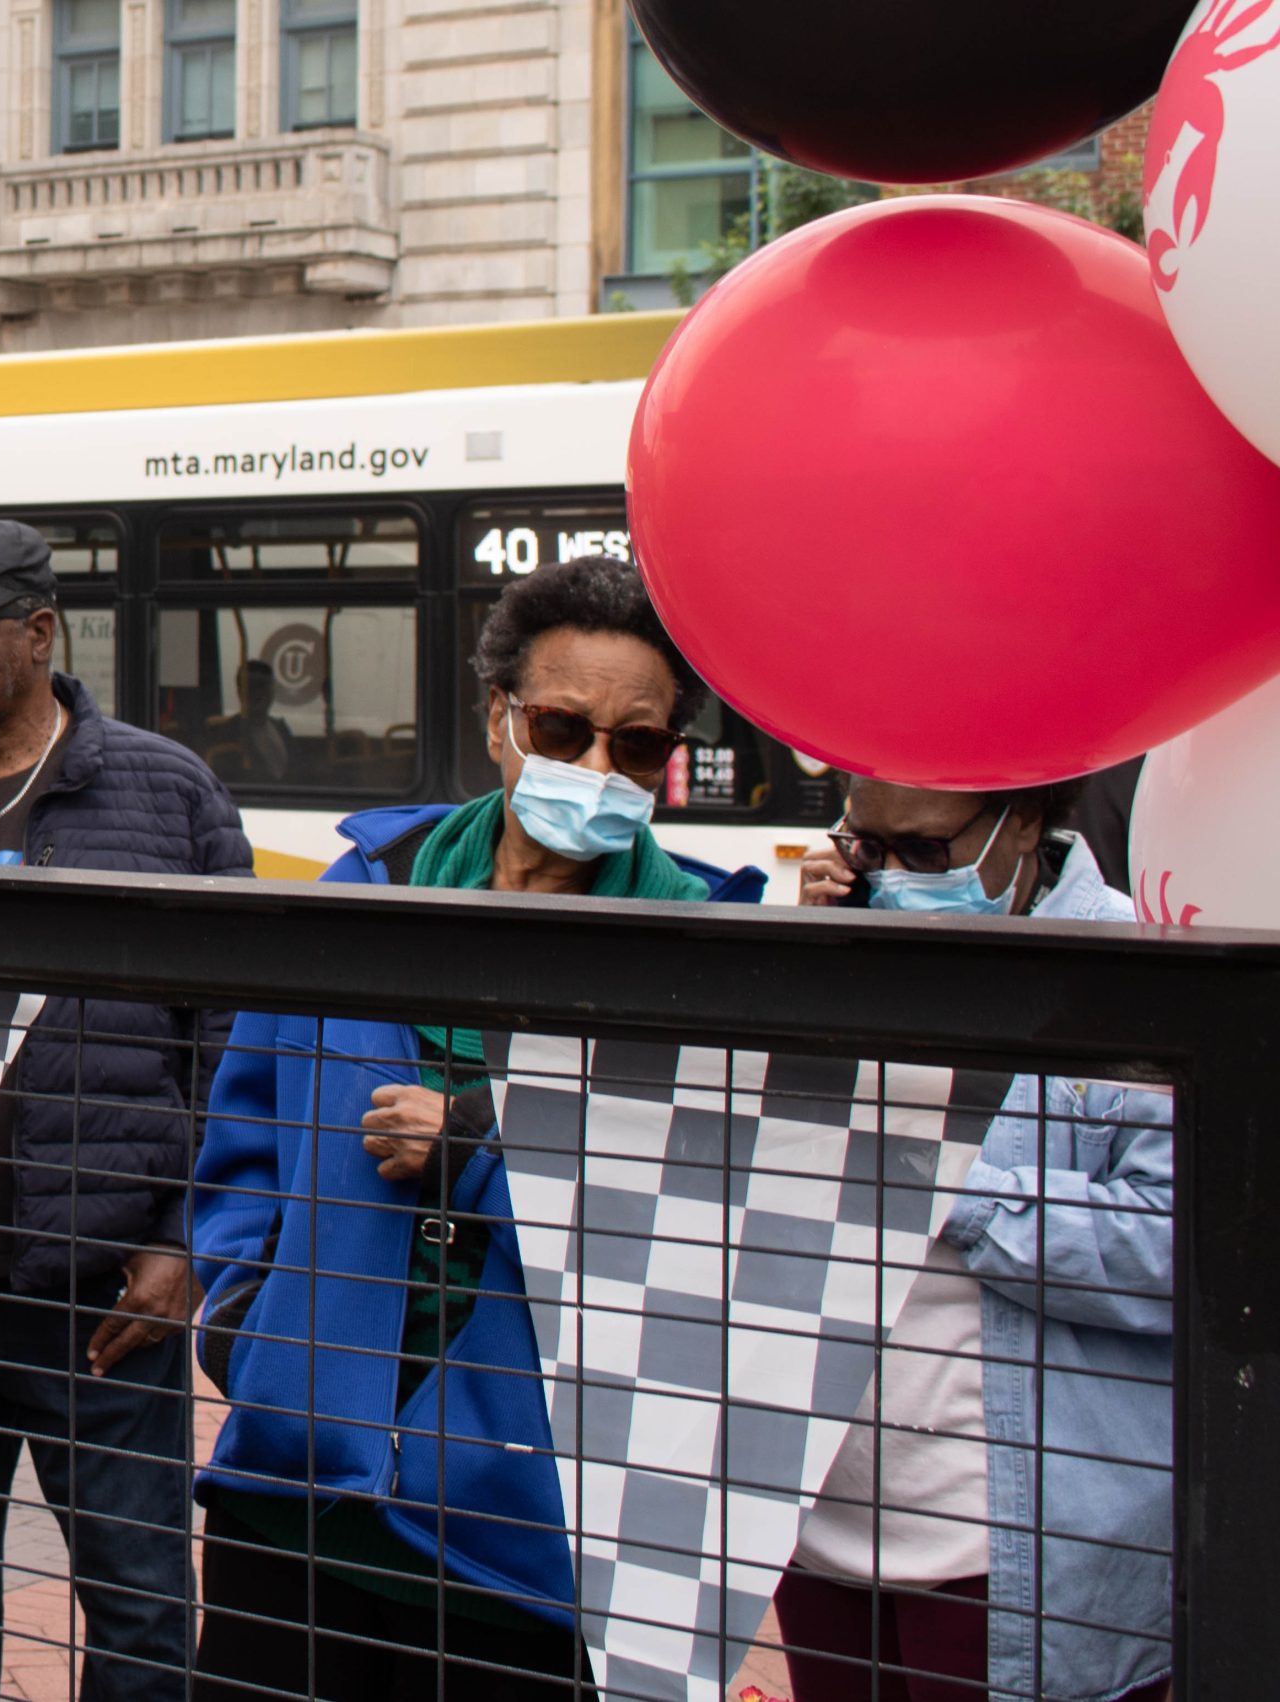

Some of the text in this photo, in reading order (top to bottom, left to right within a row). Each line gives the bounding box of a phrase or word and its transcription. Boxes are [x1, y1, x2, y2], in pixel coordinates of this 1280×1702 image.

[144, 443, 429, 480] mta.maryland.gov
[474, 528, 635, 575] 40 WES
[80, 617, 113, 640] Kit
